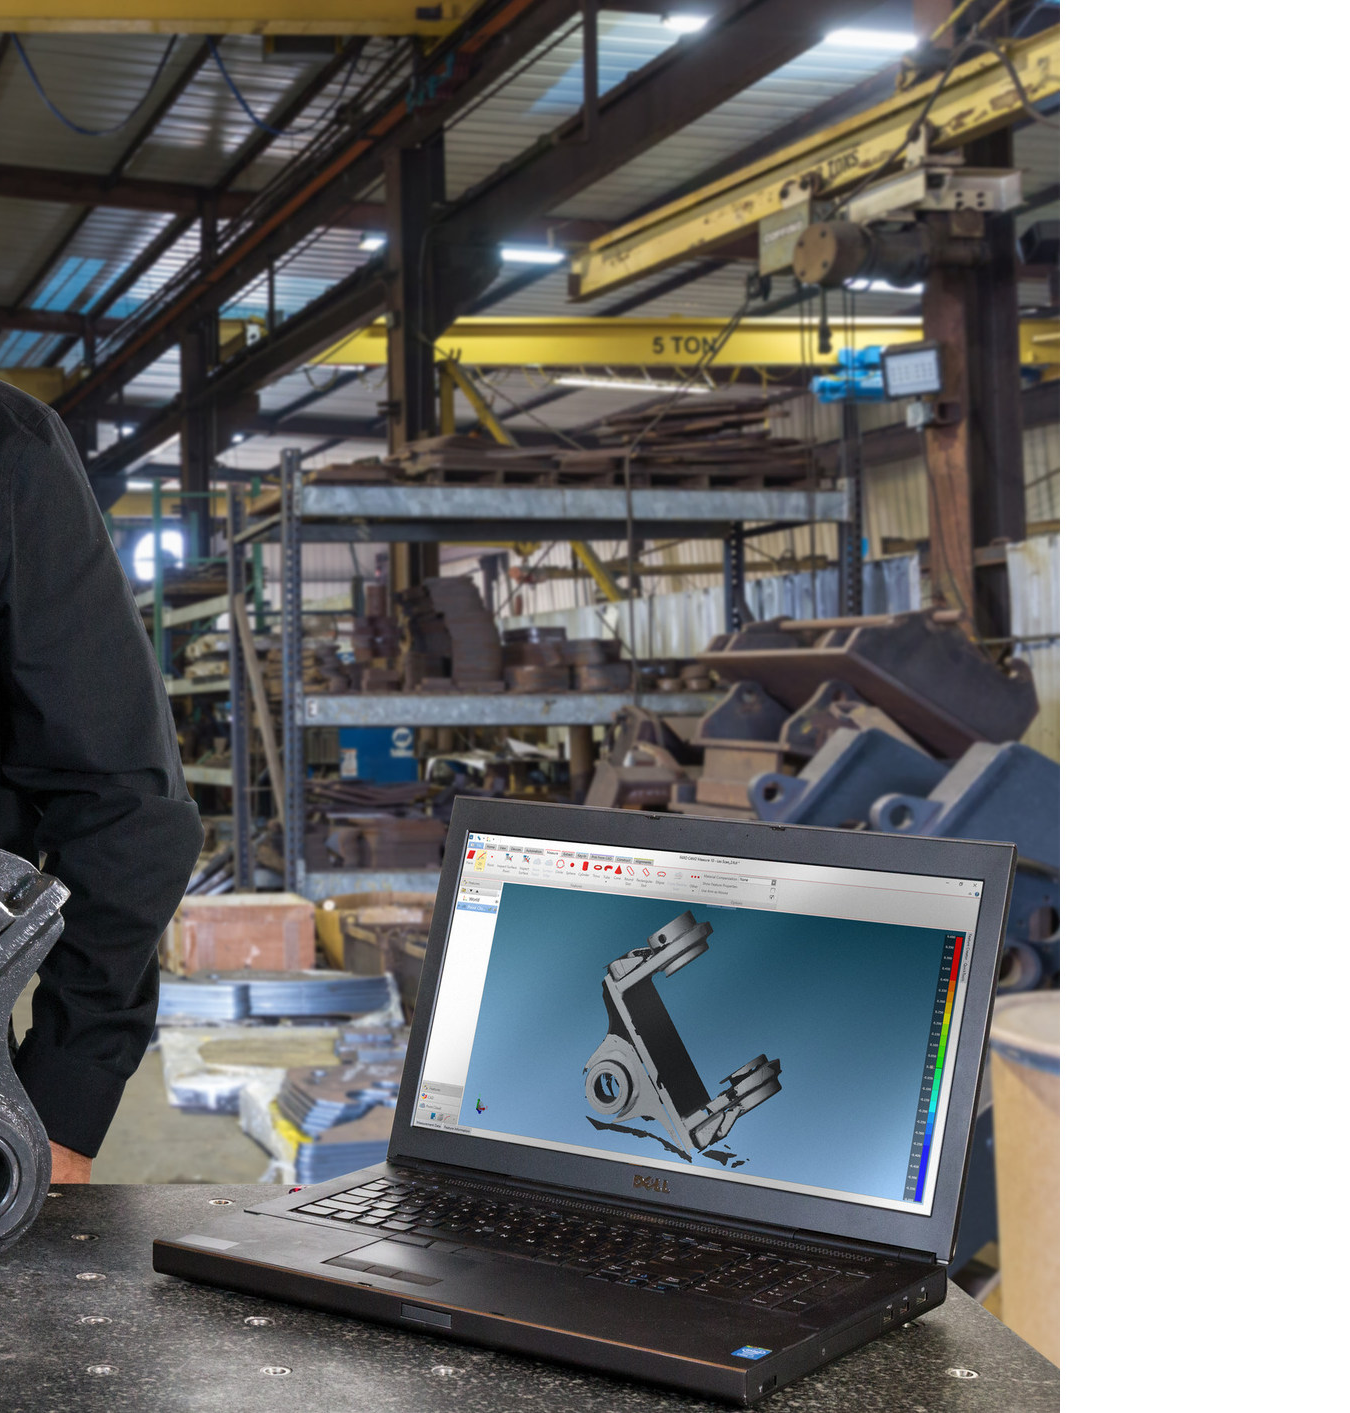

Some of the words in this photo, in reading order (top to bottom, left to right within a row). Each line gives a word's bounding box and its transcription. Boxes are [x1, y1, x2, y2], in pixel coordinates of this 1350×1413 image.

[653, 336, 664, 354] 5
[671, 336, 717, 354] TON
[633, 1175, 671, 1194] DELL
